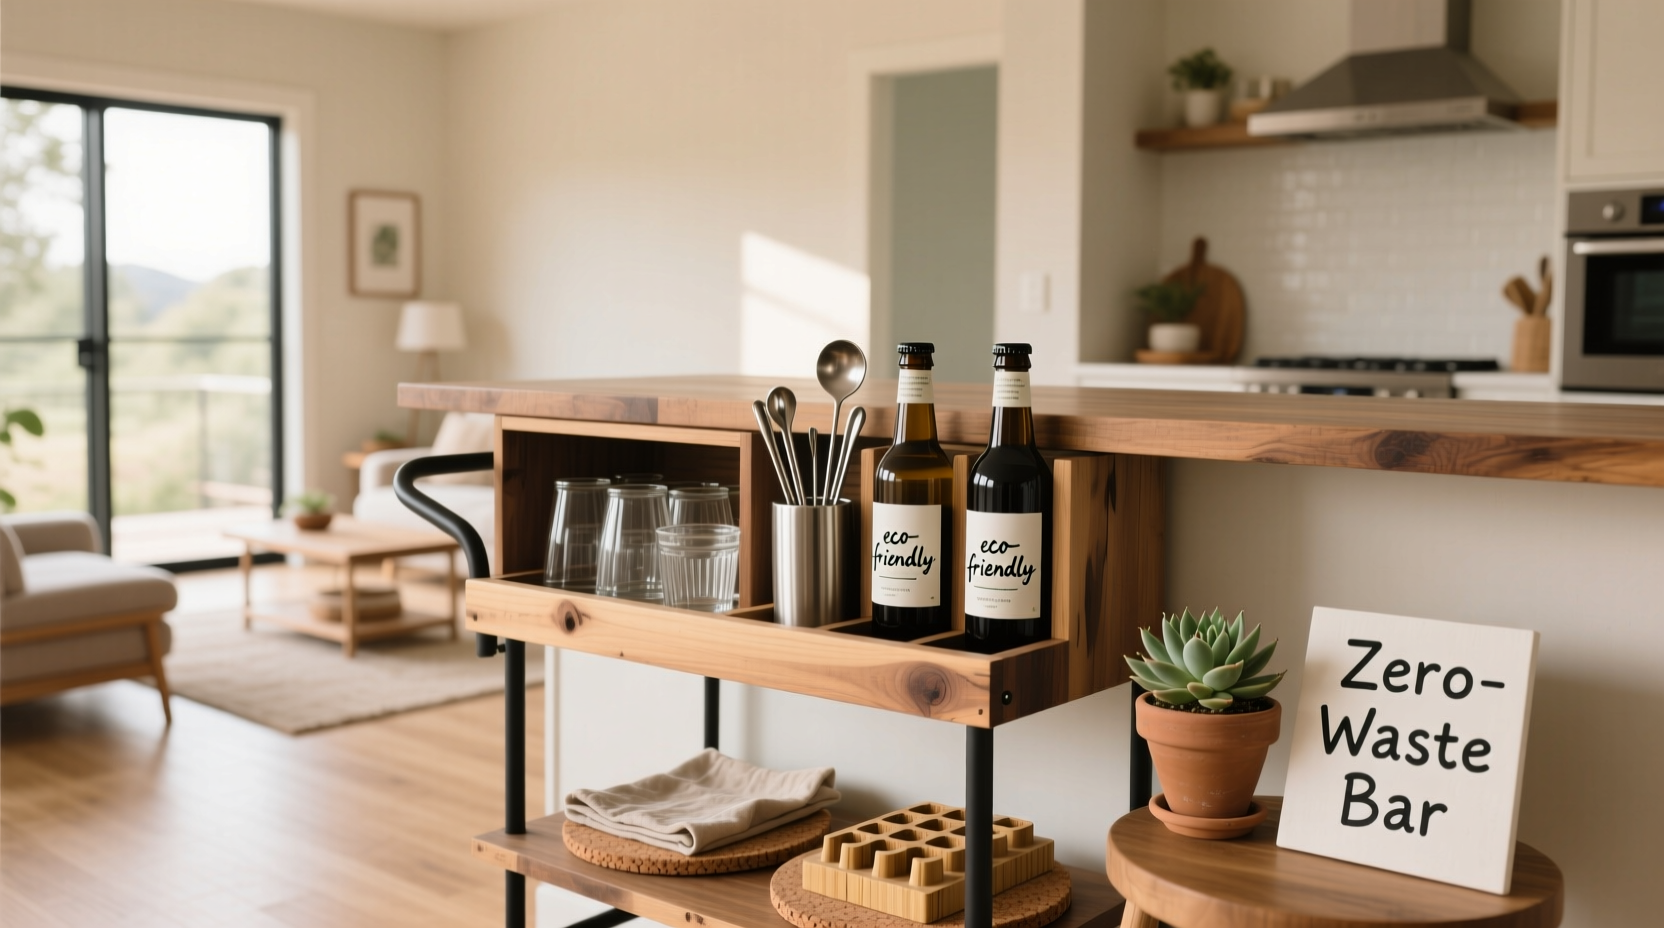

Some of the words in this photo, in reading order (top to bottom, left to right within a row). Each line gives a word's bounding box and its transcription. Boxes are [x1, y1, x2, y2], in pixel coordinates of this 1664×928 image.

[872, 542, 936, 575] friendly
[883, 531, 920, 545] eco-
[967, 553, 1037, 586] friendly
[1341, 638, 1505, 700] Zero-
[1320, 704, 1491, 774] Waste
[1340, 771, 1448, 837] Bar
